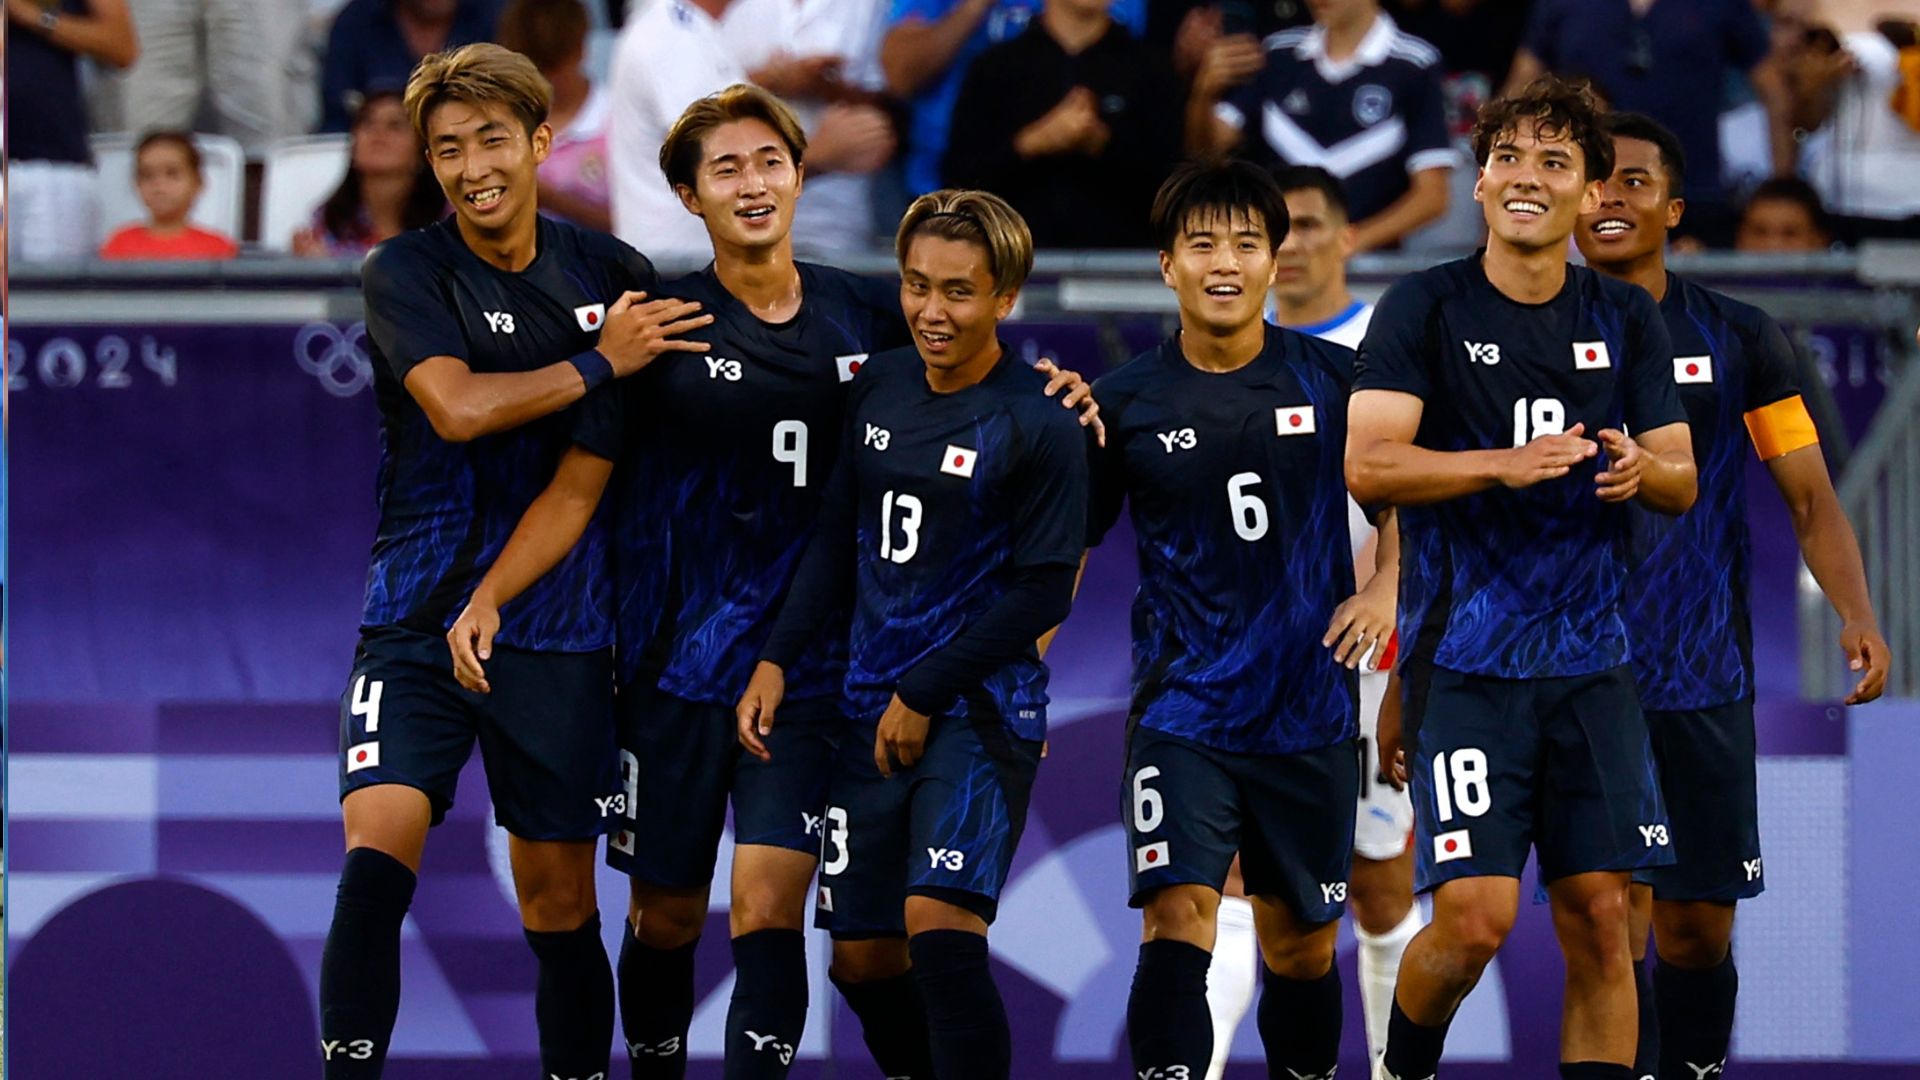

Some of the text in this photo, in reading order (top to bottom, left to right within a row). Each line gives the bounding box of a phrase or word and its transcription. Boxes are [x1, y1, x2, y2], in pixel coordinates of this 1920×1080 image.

[484, 311, 515, 334] Y-3
[1463, 340, 1504, 366] Y-3
[704, 356, 742, 382] Y-3
[1513, 397, 1565, 449] 18
[864, 423, 890, 451] Y-3
[1157, 427, 1197, 453] Y-3
[772, 419, 808, 487] 9
[1227, 471, 1269, 542] 6
[880, 490, 923, 564] 13
[350, 674, 384, 733] 4
[1433, 747, 1492, 822] 18
[594, 793, 626, 818] Y-3
[1133, 765, 1164, 833] 6
[821, 805, 850, 876] 3
[1638, 824, 1669, 847] Y-3
[927, 847, 964, 871] Y-3
[1320, 881, 1347, 904] Y-3
[321, 1039, 374, 1061] Y-3
[625, 1036, 680, 1058] Y-3
[744, 1030, 793, 1066] Y-3
